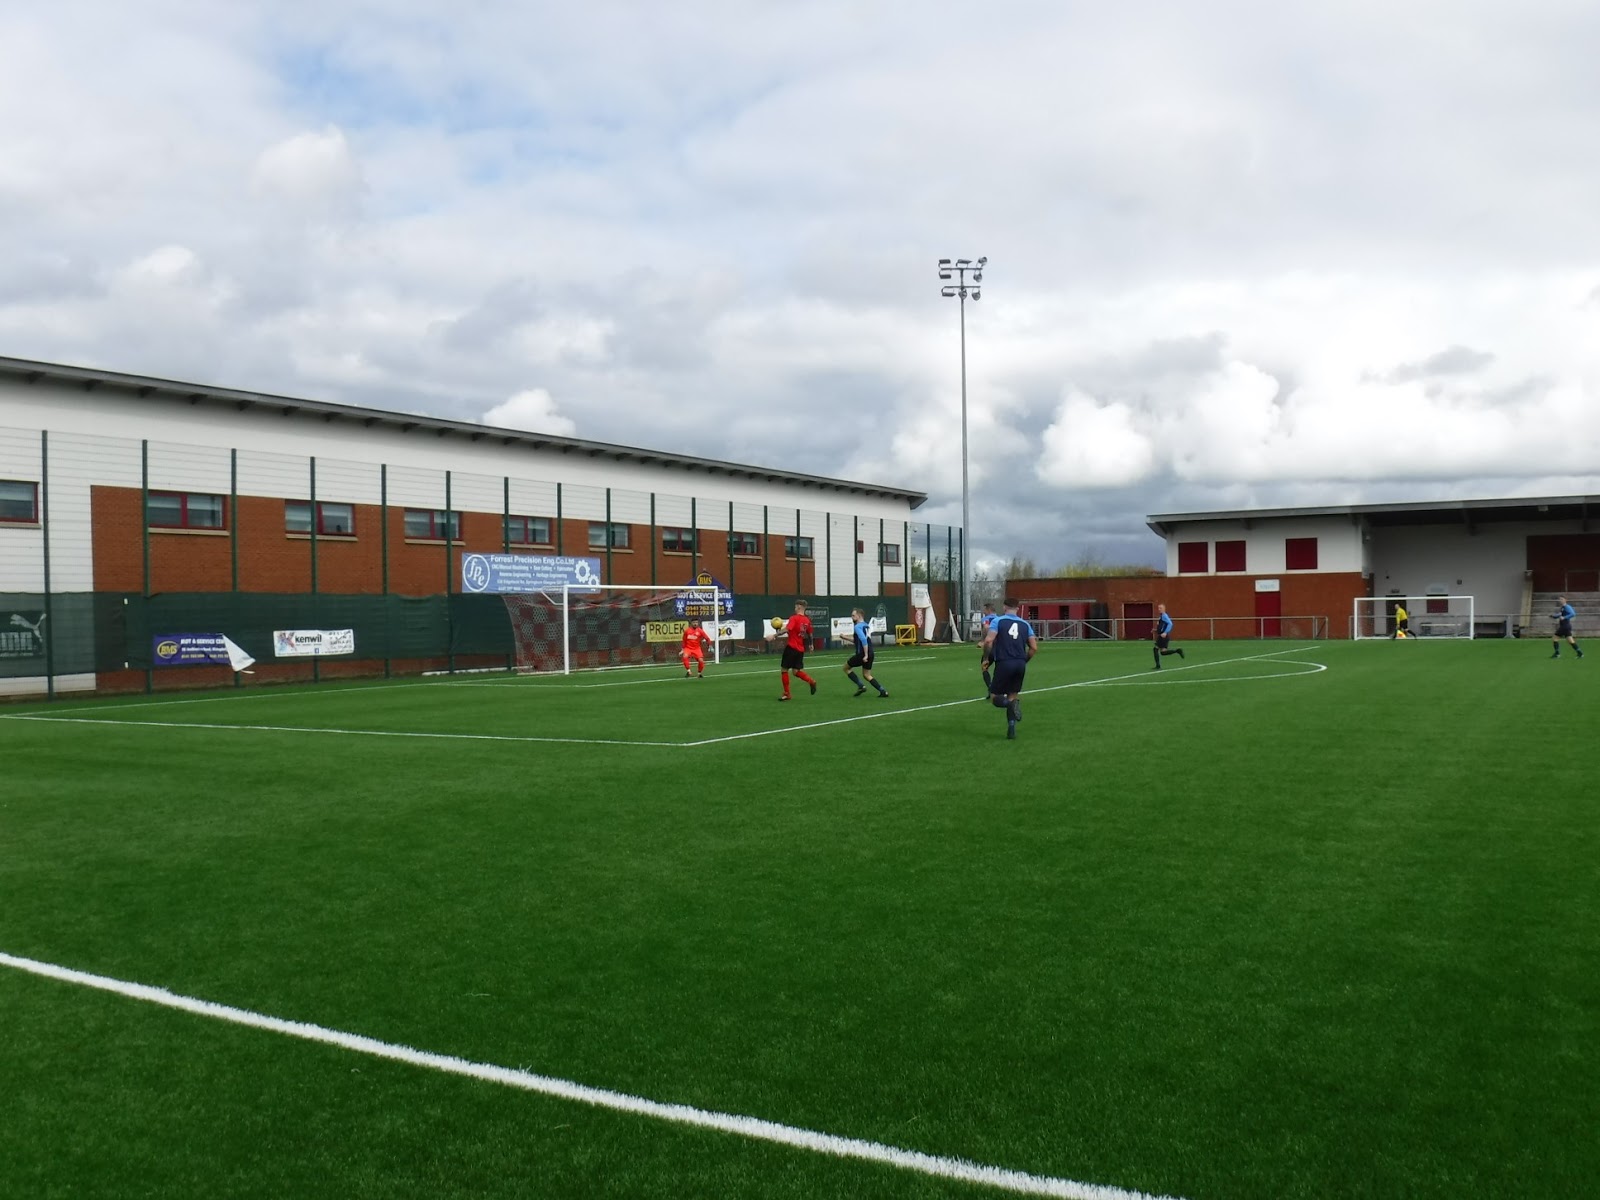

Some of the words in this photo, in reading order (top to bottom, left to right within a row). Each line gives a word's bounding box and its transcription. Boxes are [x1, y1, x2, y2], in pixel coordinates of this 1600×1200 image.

[490, 555, 513, 563] Forrest
[514, 556, 542, 564] Precision
[699, 576, 712, 584] BMS
[649, 623, 686, 635] PROLEK
[1008, 622, 1019, 640] 4
[295, 634, 322, 643] kenwil
